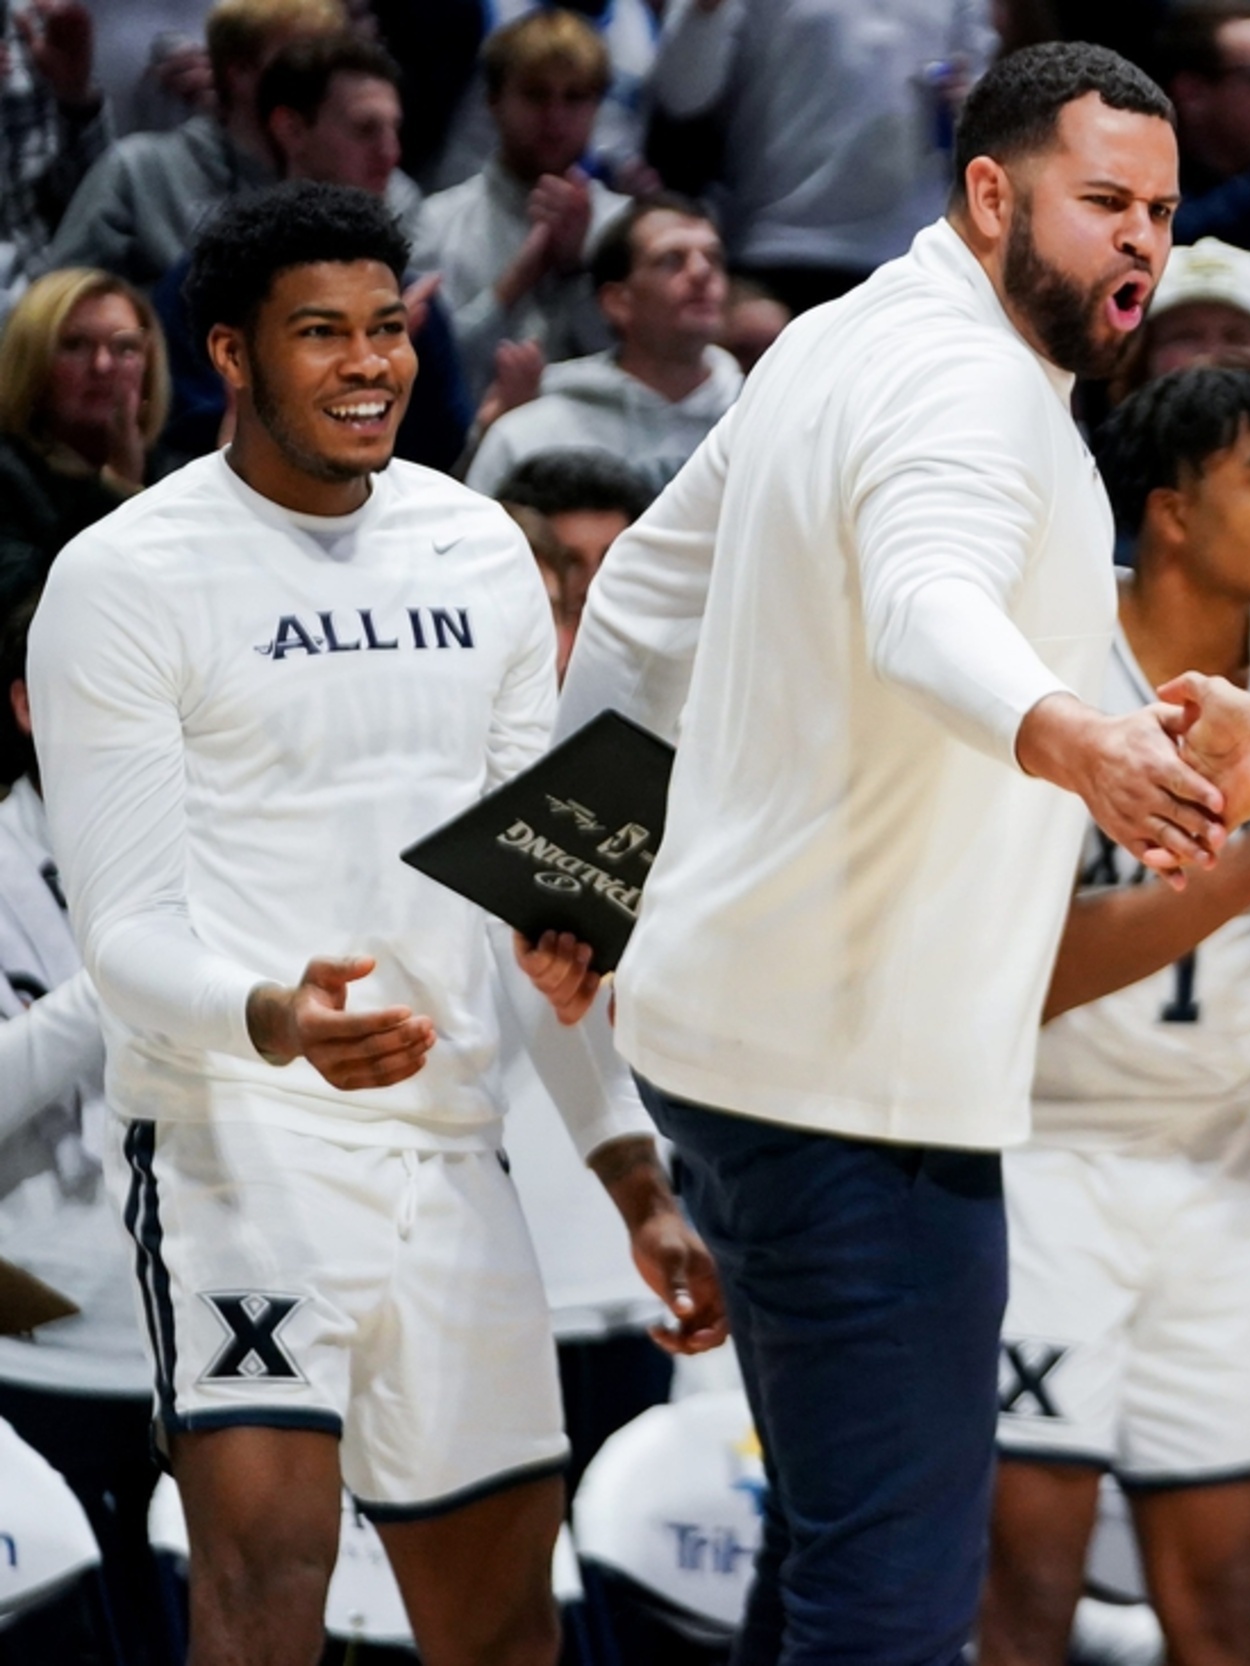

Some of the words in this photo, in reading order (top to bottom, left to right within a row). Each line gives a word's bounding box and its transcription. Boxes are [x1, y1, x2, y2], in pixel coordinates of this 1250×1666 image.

[254, 609, 399, 660] ALL
[406, 607, 475, 650] IN
[496, 818, 642, 920] PALDING
